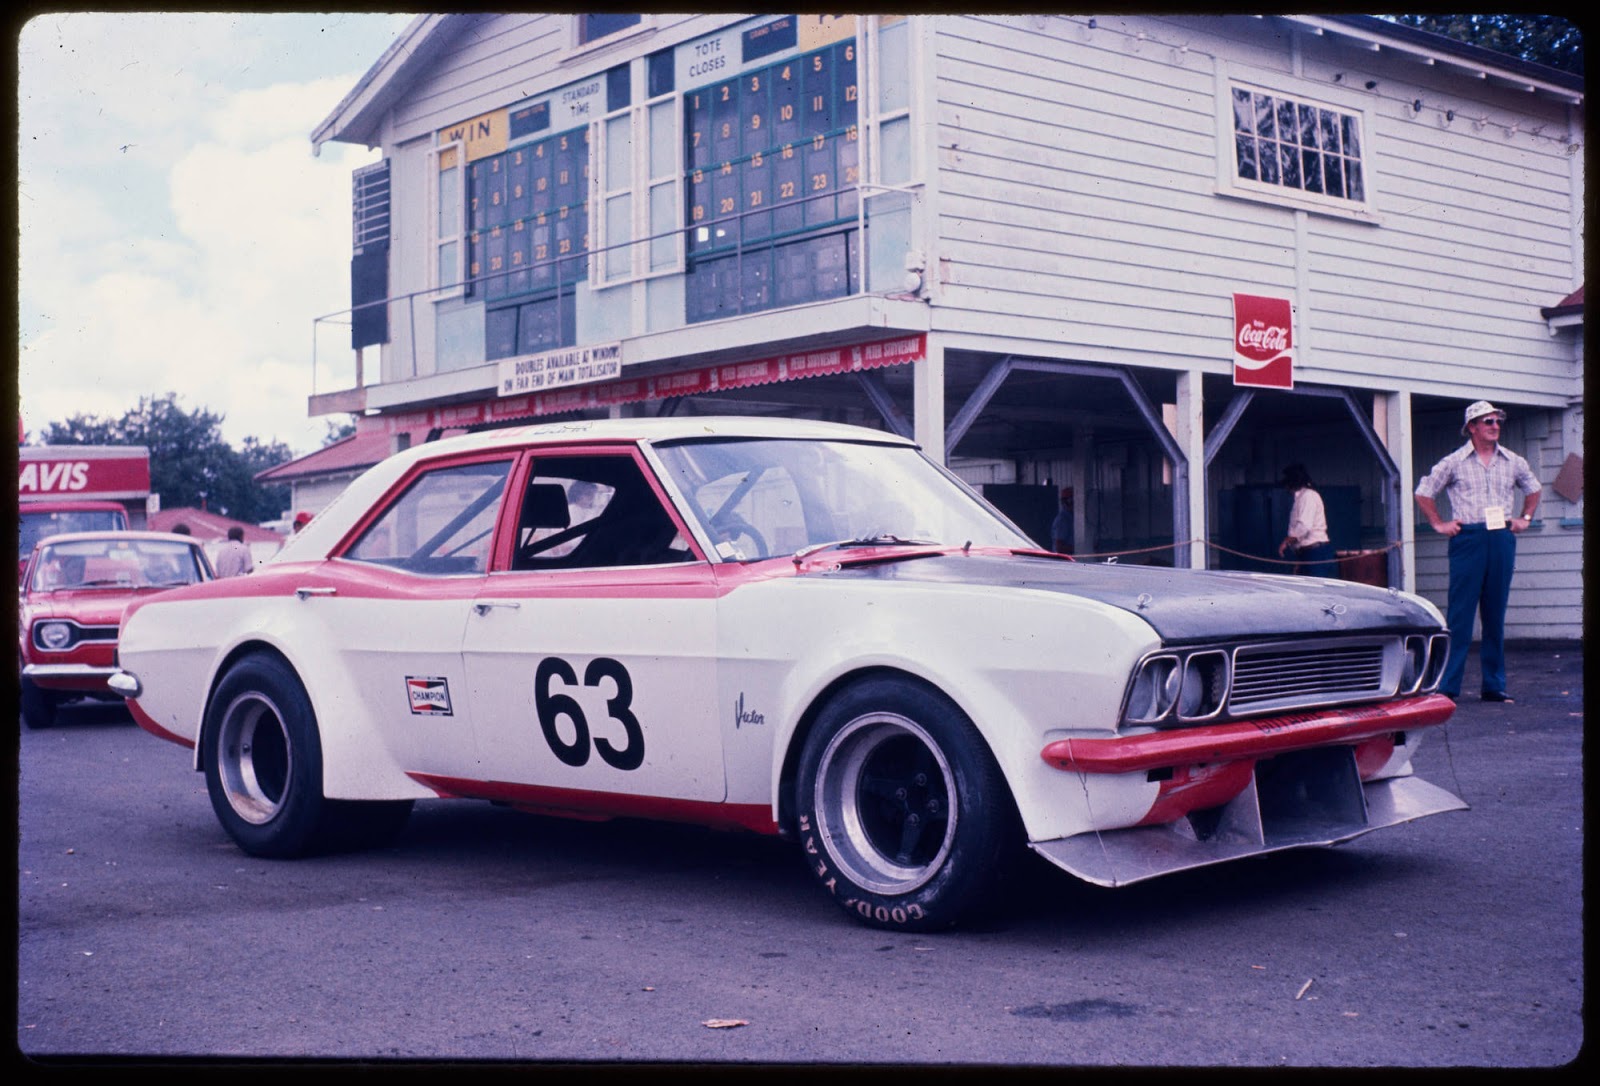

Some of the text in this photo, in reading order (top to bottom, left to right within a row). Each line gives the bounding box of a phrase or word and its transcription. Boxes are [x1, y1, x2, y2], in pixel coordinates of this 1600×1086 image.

[696, 39, 721, 56] TOTE
[689, 55, 726, 77] CLOSES
[694, 45, 854, 110] 1 2 3 4 5 6
[449, 118, 490, 142] WIN
[693, 85, 857, 147] 7 8 9 10 11 12
[693, 124, 857, 184] 13 14 15 16 17 18
[693, 166, 857, 221] 19 20 21 22 23 24
[515, 358, 545, 376] DOUBLES
[546, 352, 581, 370] AVAILABLE
[582, 350, 590, 363] AT
[516, 377, 529, 389] FAR
[558, 368, 575, 383] MAIN
[578, 361, 618, 380] TOTALISATOR
[19, 461, 90, 491] AVIS
[412, 690, 446, 701] CHAMPION
[735, 691, 765, 730] Victor
[534, 656, 646, 772] 63
